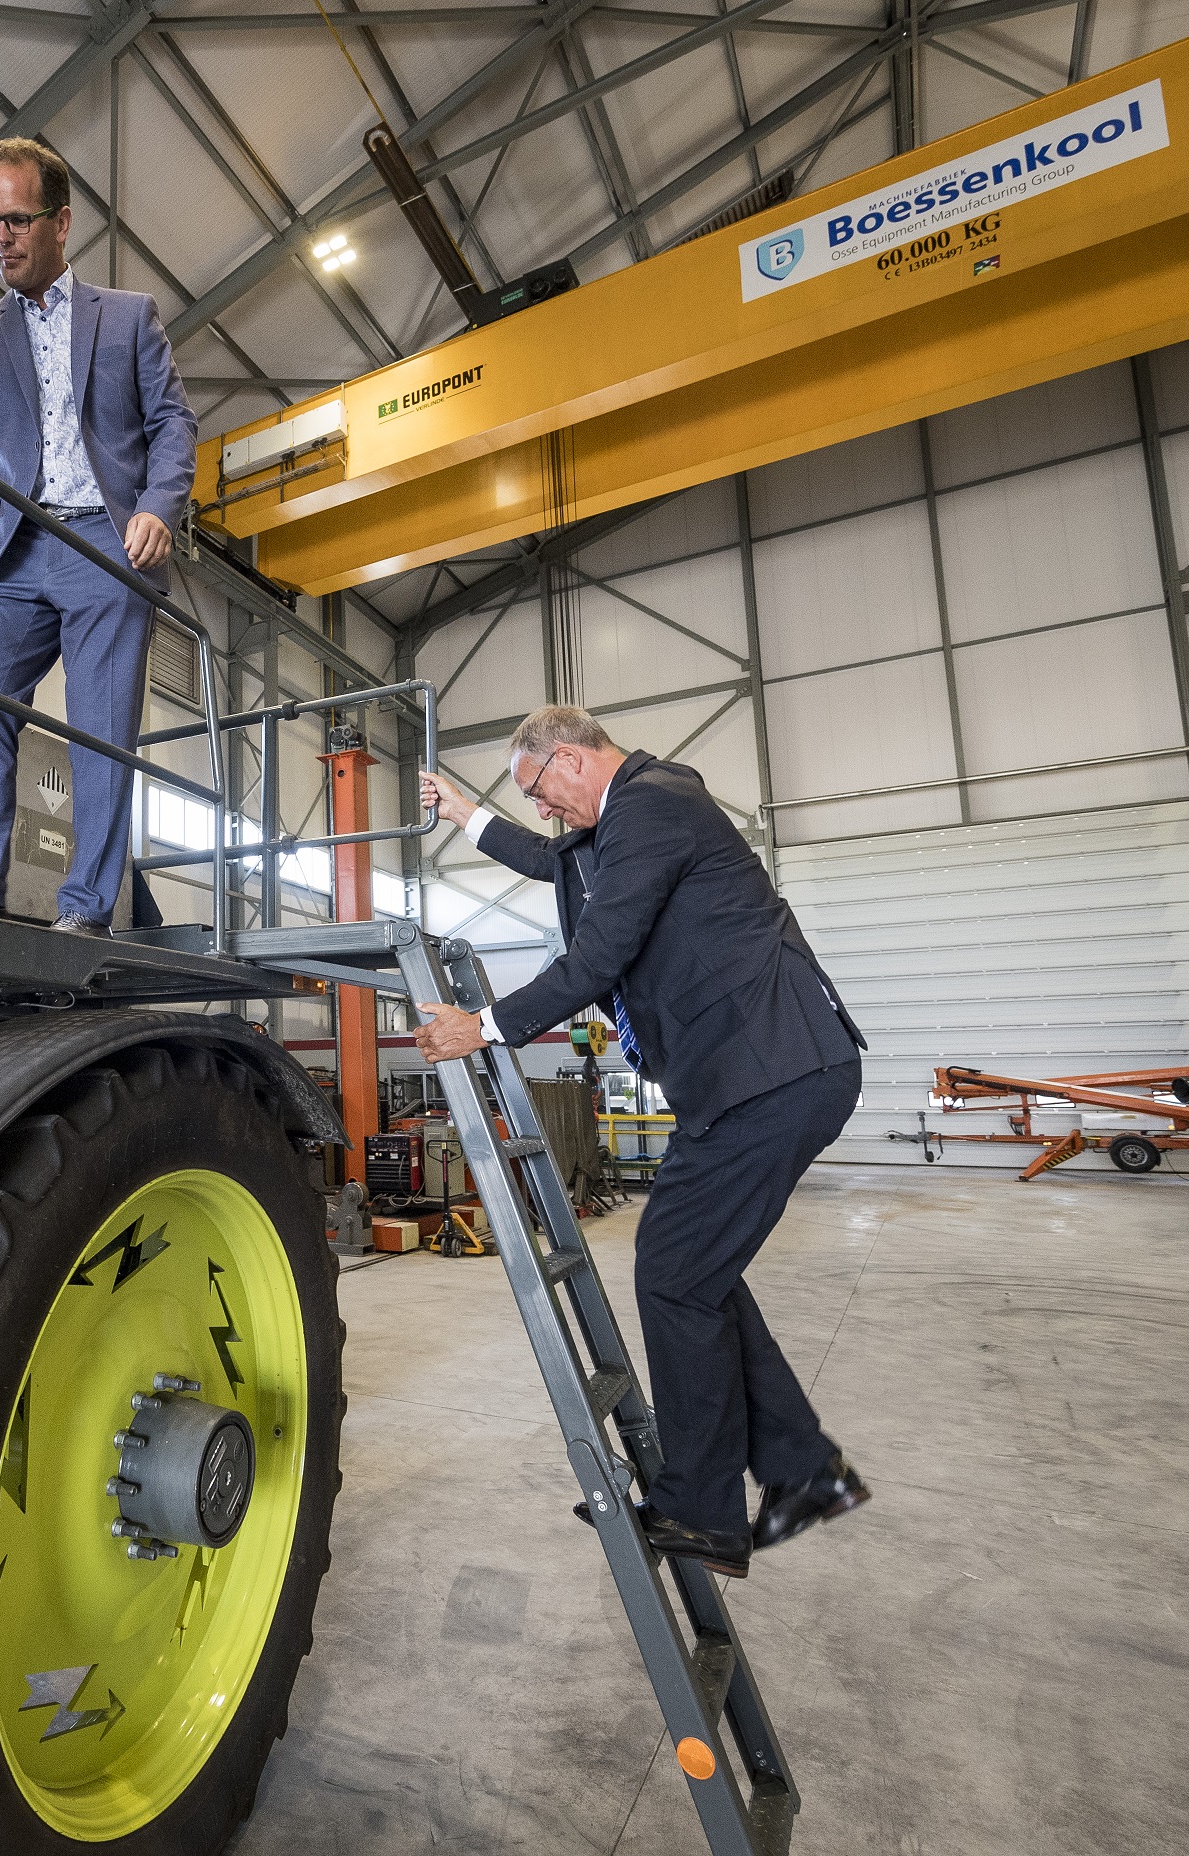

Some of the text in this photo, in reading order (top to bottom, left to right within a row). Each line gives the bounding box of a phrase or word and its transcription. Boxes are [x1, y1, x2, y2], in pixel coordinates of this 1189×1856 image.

[827, 100, 1143, 248] Boessenkool
[868, 168, 967, 212] MACHINEFABRIEK
[831, 163, 1075, 262] Osse Equipment Manufacturing Group
[877, 211, 1002, 271] 60.000 KG
[970, 233, 997, 252] 2434
[402, 364, 484, 409] EUROPONT
[415, 397, 444, 412] VERLINDE
[41, 835, 51, 845] UN
